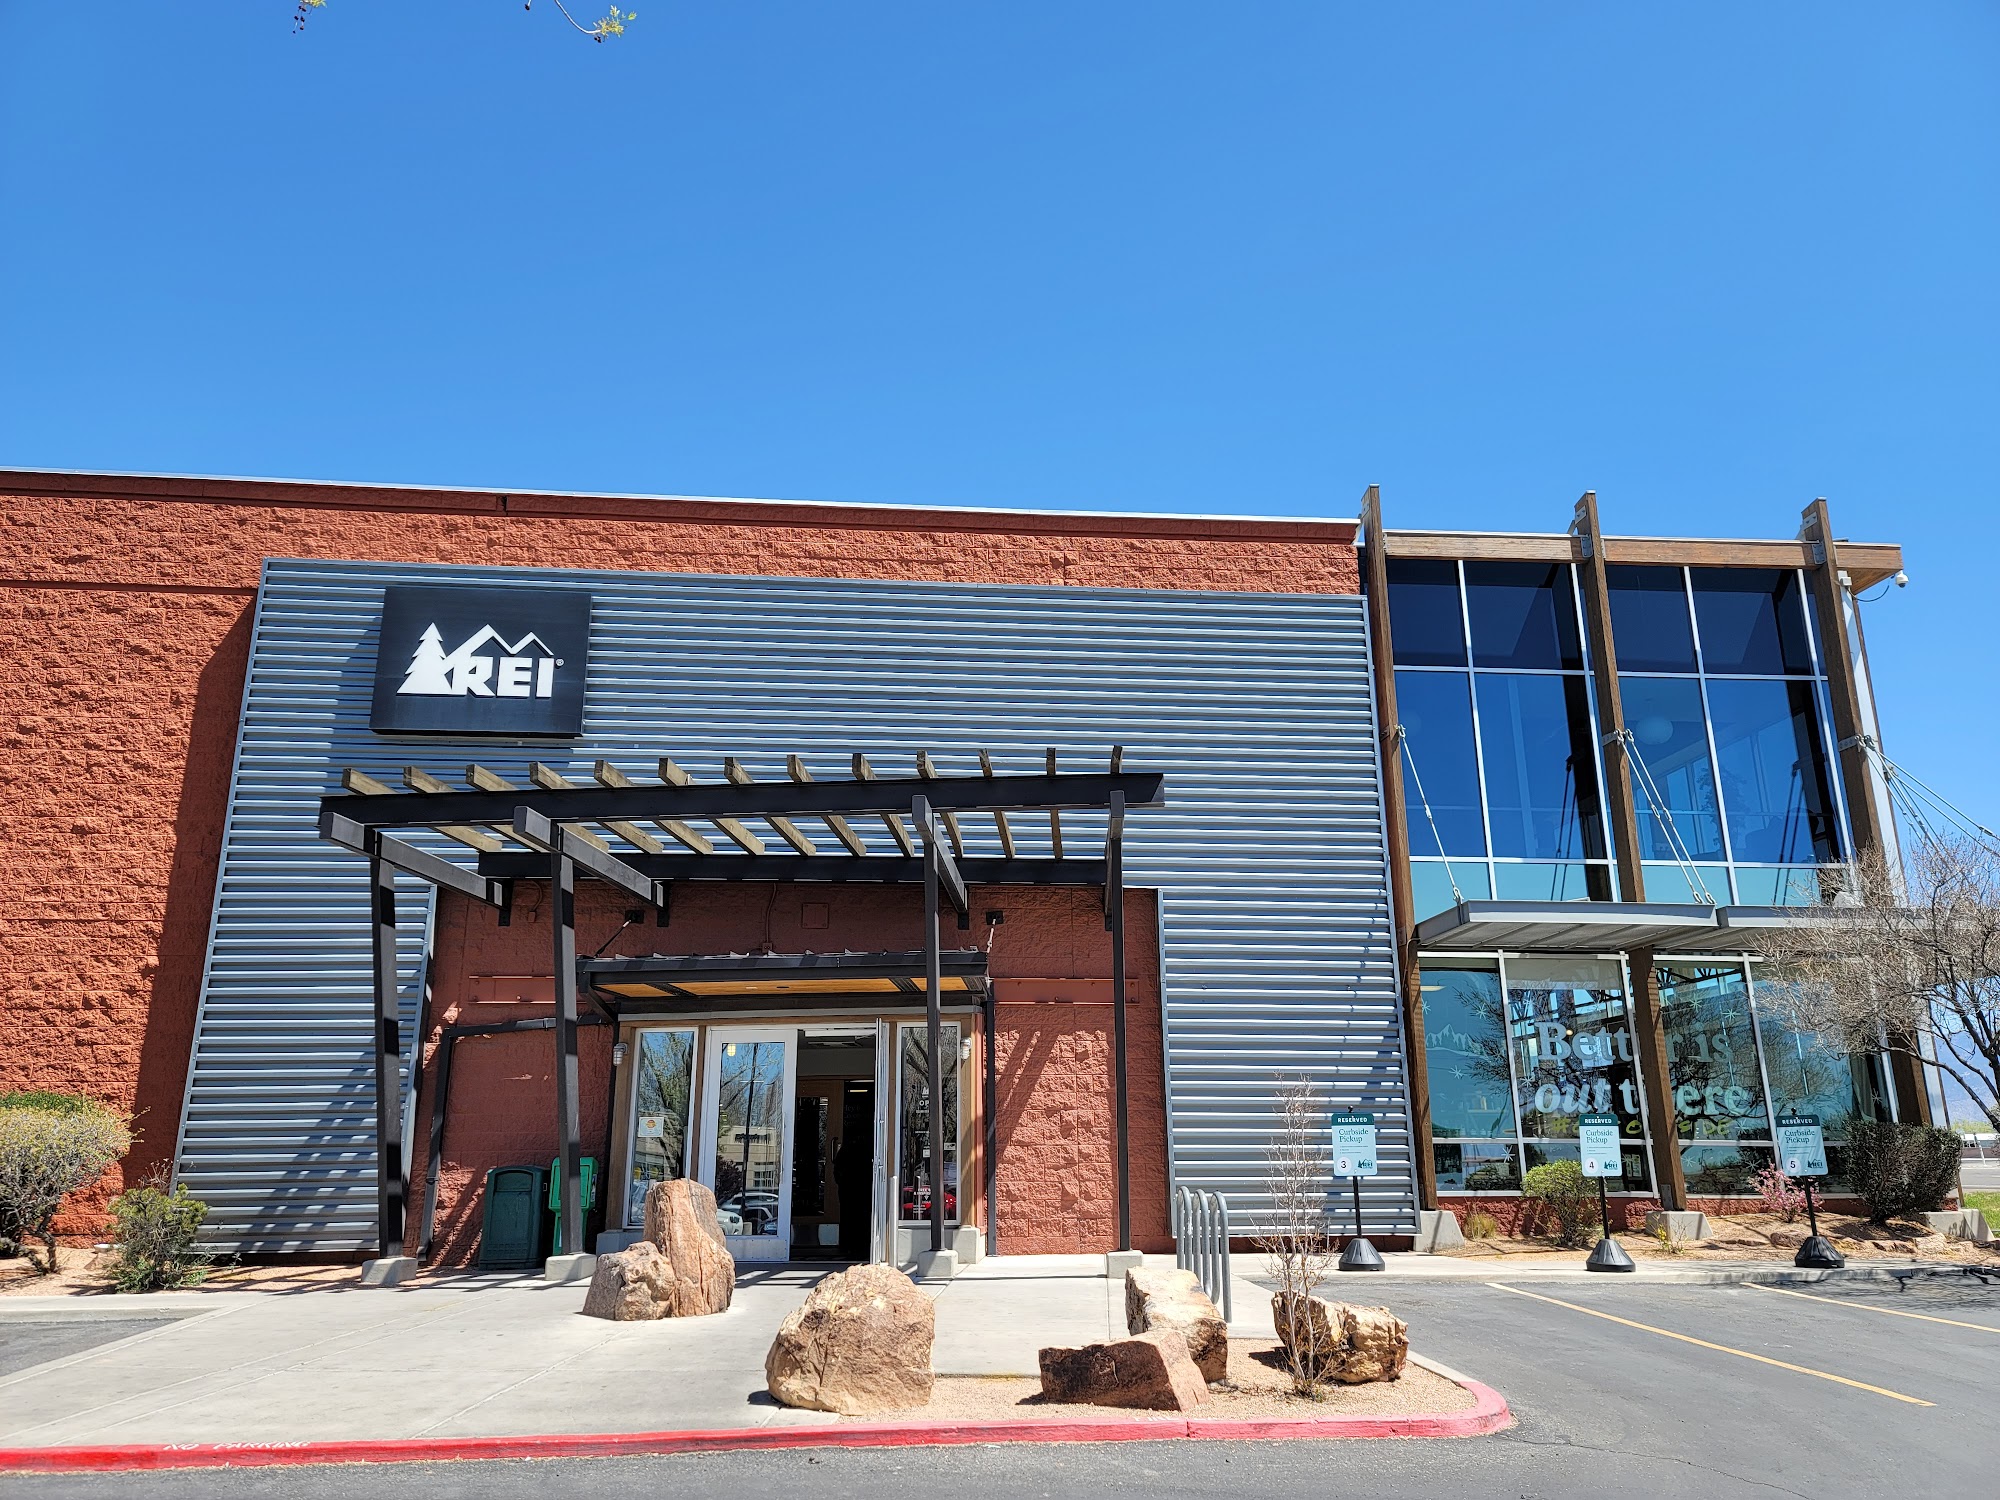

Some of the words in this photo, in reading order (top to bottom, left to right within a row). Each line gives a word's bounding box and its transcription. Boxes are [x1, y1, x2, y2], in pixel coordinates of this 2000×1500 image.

[452, 656, 554, 698] REI
[1535, 1021, 1684, 1062] Bettr
[1695, 1033, 1734, 1062] is
[1535, 1078, 1613, 1113] out
[1618, 1078, 1751, 1116] tere
[1585, 1129, 1613, 1137] Curbside
[1784, 1129, 1815, 1137] Curbside
[1339, 1135, 1363, 1143] Pickup
[1586, 1136, 1608, 1144] Pickup
[1785, 1136, 1810, 1144] Pickup
[1340, 1160, 1347, 1169] 3
[1589, 1161, 1595, 1169] 4
[1790, 1160, 1796, 1169] 5
[212, 1441, 311, 1450] PARKING
